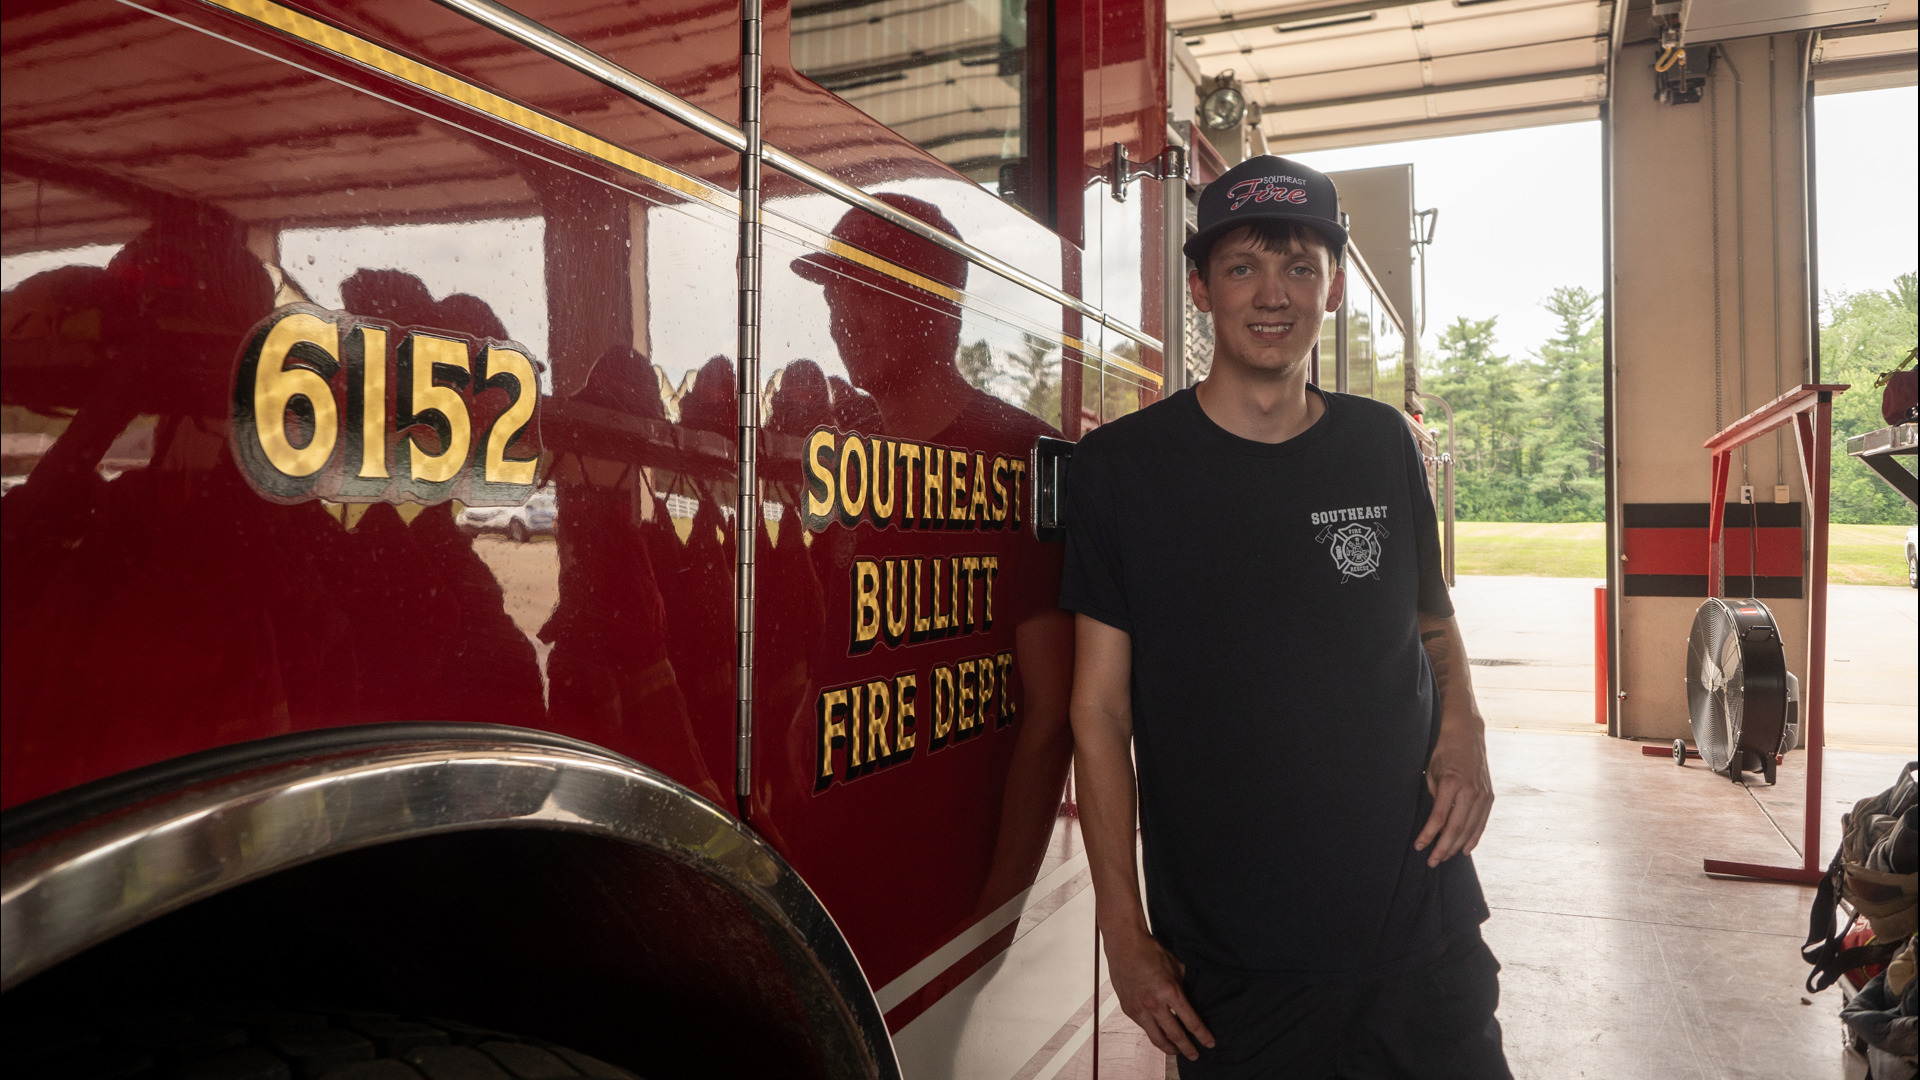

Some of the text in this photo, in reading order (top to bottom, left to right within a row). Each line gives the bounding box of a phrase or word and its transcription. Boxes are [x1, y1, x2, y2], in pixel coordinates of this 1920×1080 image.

[1227, 178, 1307, 210] Fire
[1263, 176, 1307, 186] SOUTHEAST
[254, 313, 538, 485] 6152
[807, 429, 1026, 521] SOUTHEAST
[1310, 505, 1388, 525] SOUTHEAST
[855, 556, 998, 642] BULLITT
[820, 652, 1016, 778] FIRE DEPT.
